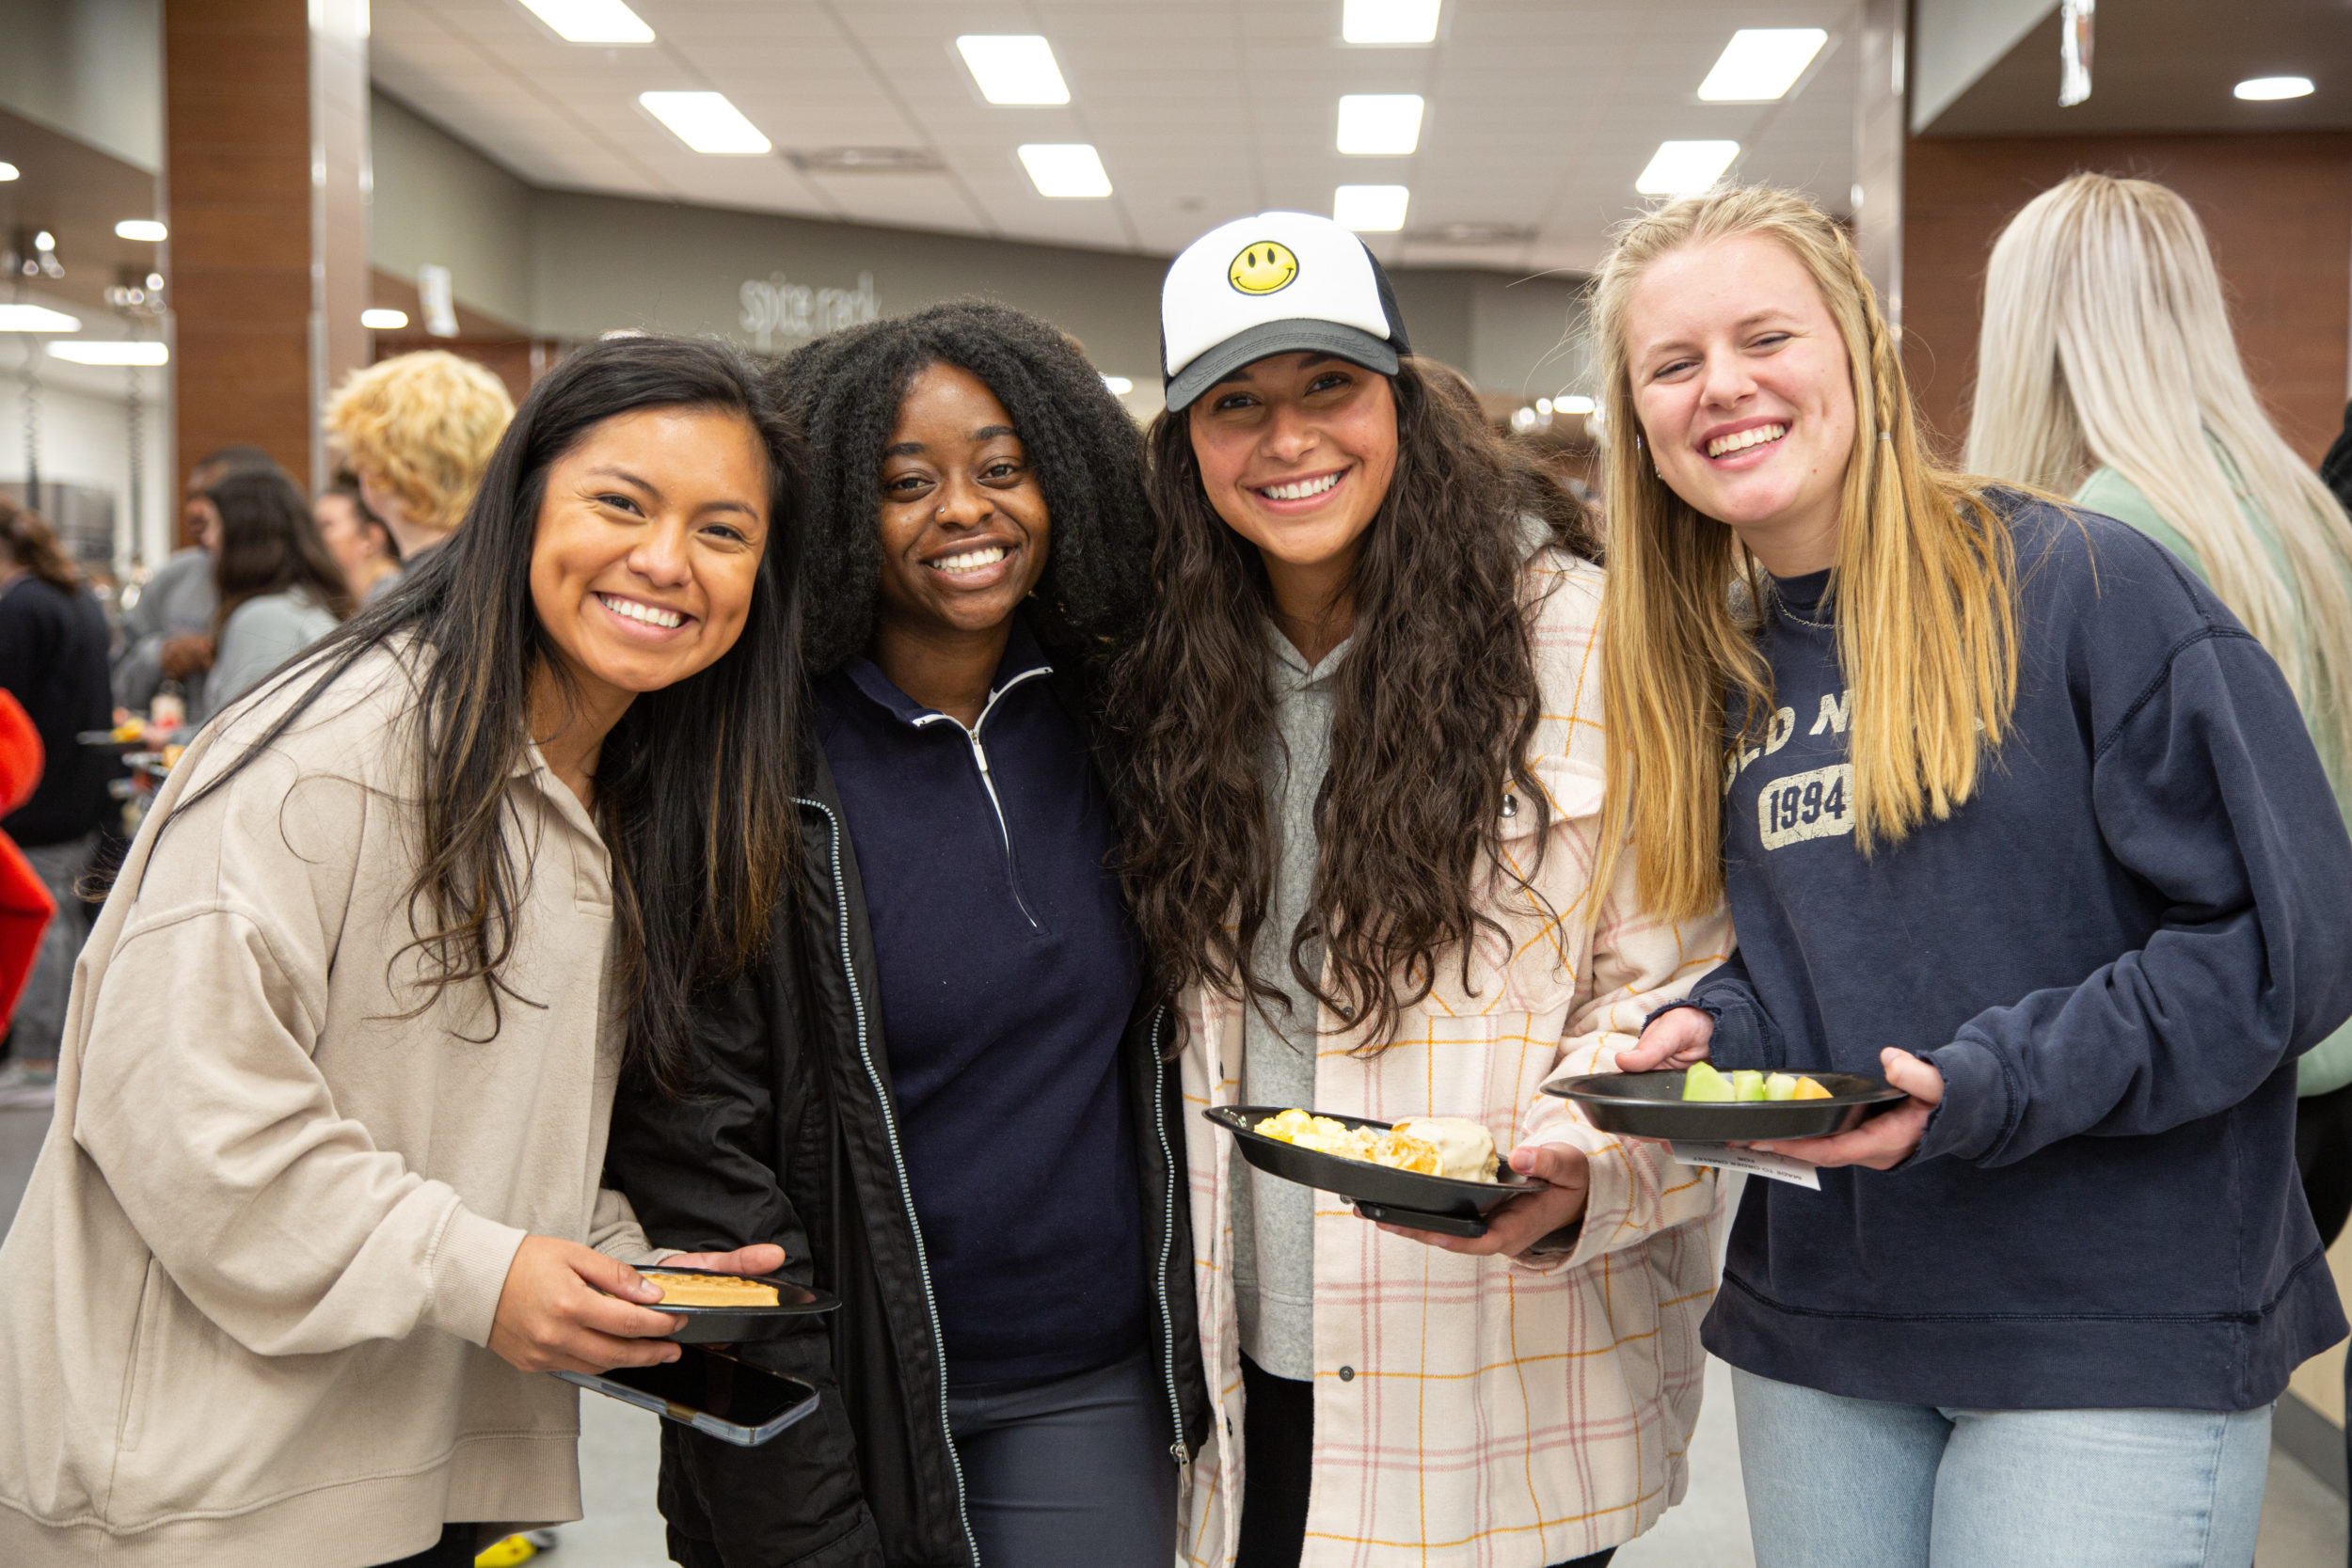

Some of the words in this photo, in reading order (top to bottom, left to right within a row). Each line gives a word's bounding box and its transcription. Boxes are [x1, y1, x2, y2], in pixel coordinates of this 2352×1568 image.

[739, 271, 815, 353] spice
[1770, 776, 1847, 834] 1994
[1693, 1156, 1728, 1165] OMELET
[1730, 1161, 1760, 1170] ORDER
[1776, 1170, 1803, 1180] MADE
